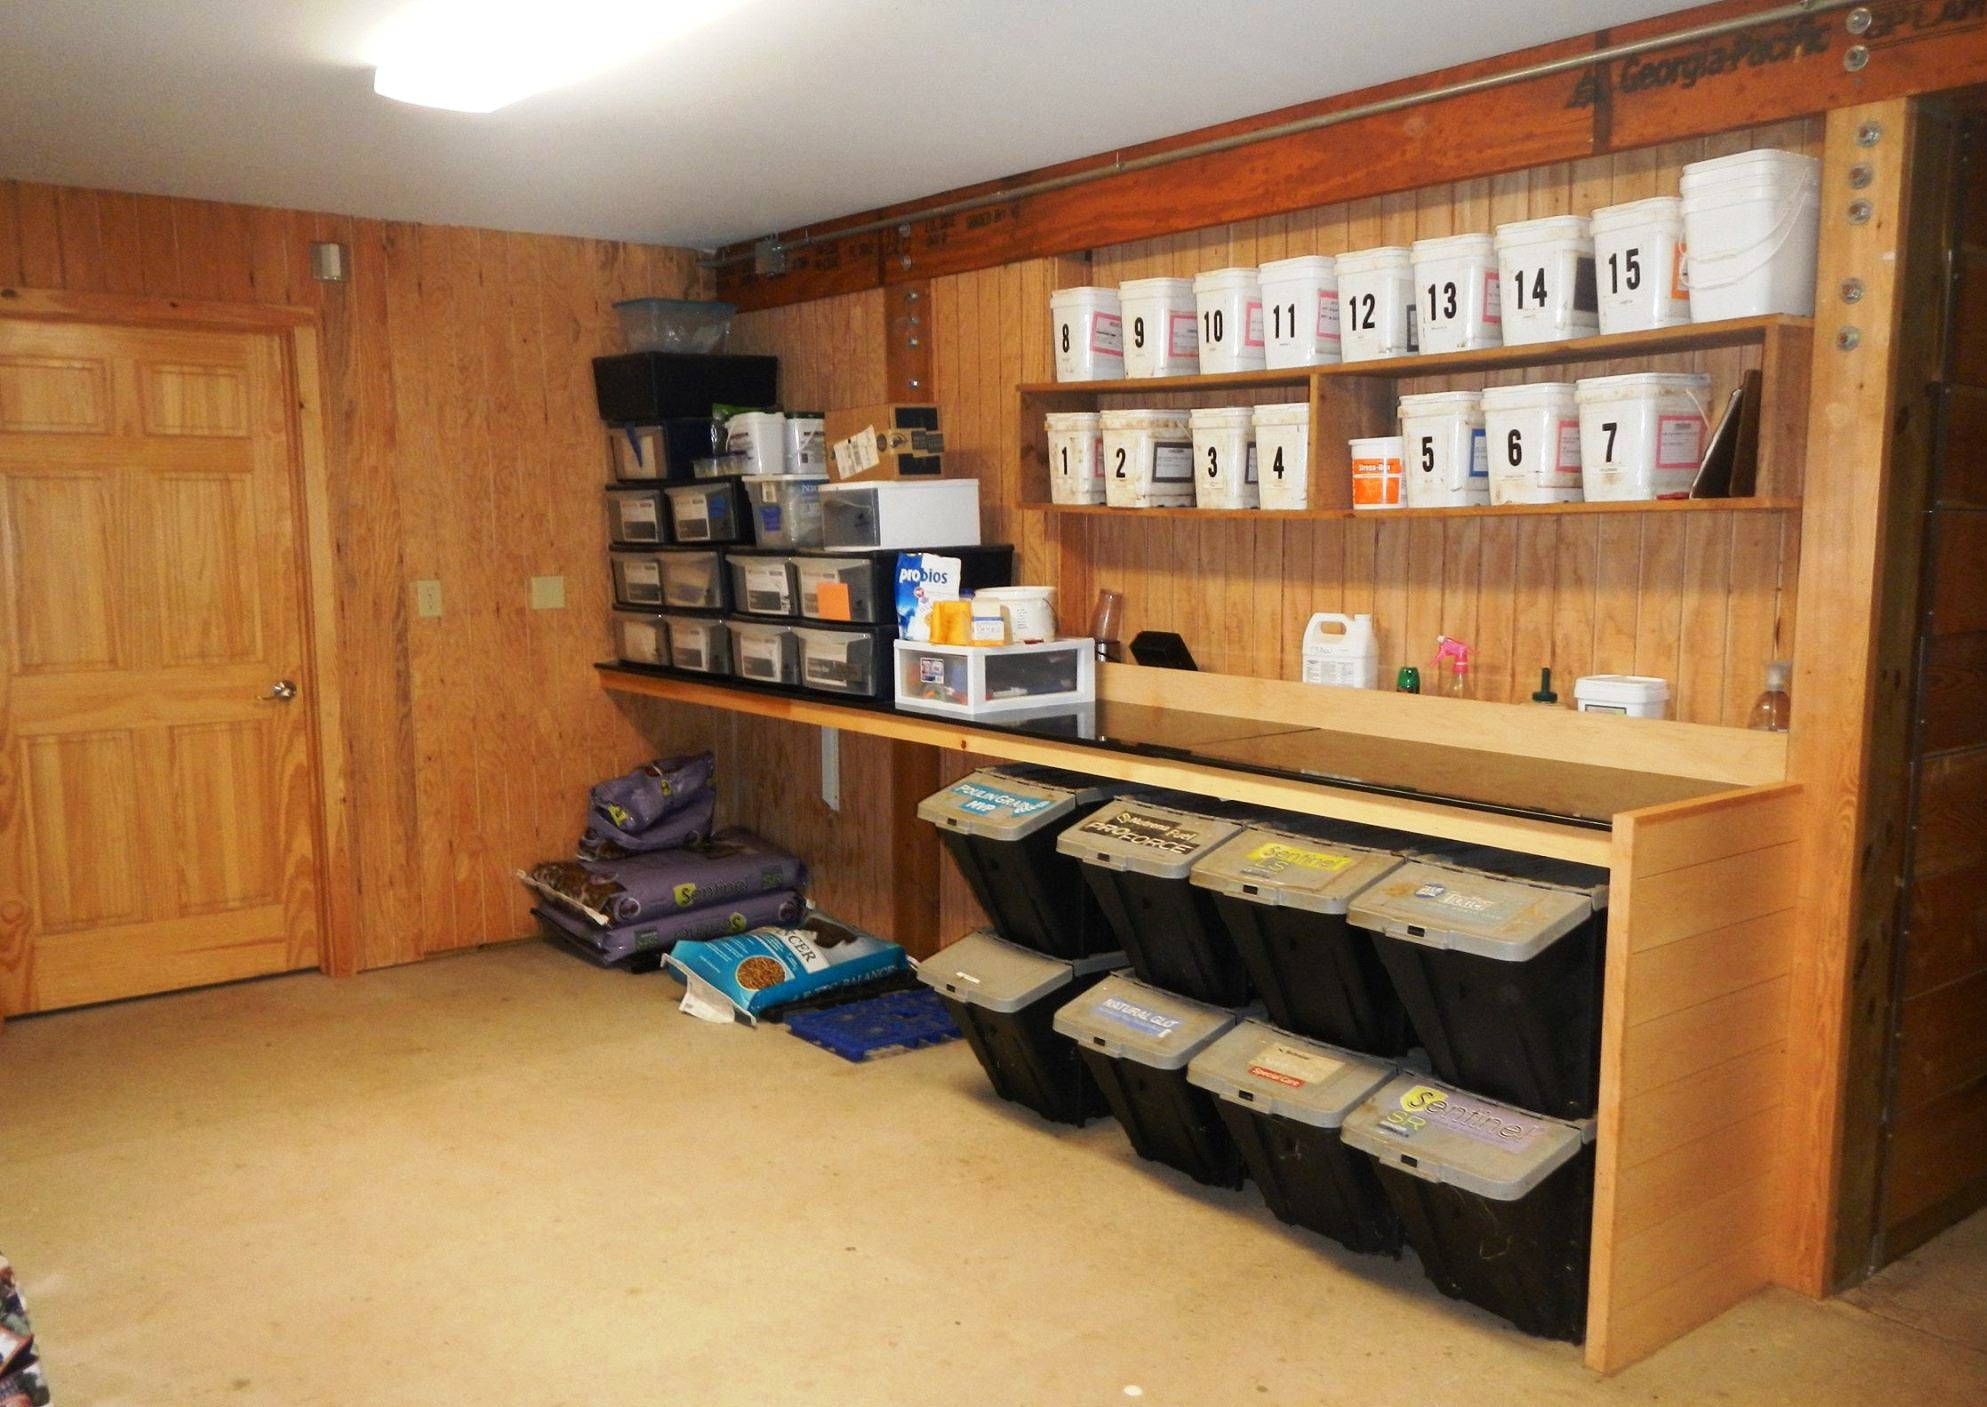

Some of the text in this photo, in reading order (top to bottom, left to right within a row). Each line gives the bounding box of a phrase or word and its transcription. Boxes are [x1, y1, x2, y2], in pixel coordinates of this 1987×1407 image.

[1515, 267, 1548, 310] 14
[1608, 248, 1641, 294] 15
[1349, 293, 1376, 331] 12
[1428, 281, 1457, 321] 13
[1062, 323, 1070, 353] 8
[1134, 317, 1145, 348] 9
[1204, 309, 1224, 344] 10
[1273, 304, 1296, 339] 11
[1422, 436, 1435, 473] 5
[1507, 429, 1523, 467] 6
[1602, 422, 1618, 463] 7
[1061, 446, 1068, 476] 1
[1115, 447, 1127, 479] 2
[1207, 446, 1218, 478] 3
[1273, 446, 1285, 480] 4
[899, 567, 949, 584] probios
[1387, 1110, 1426, 1131] SR
[1408, 1091, 1545, 1142] Sentinel
